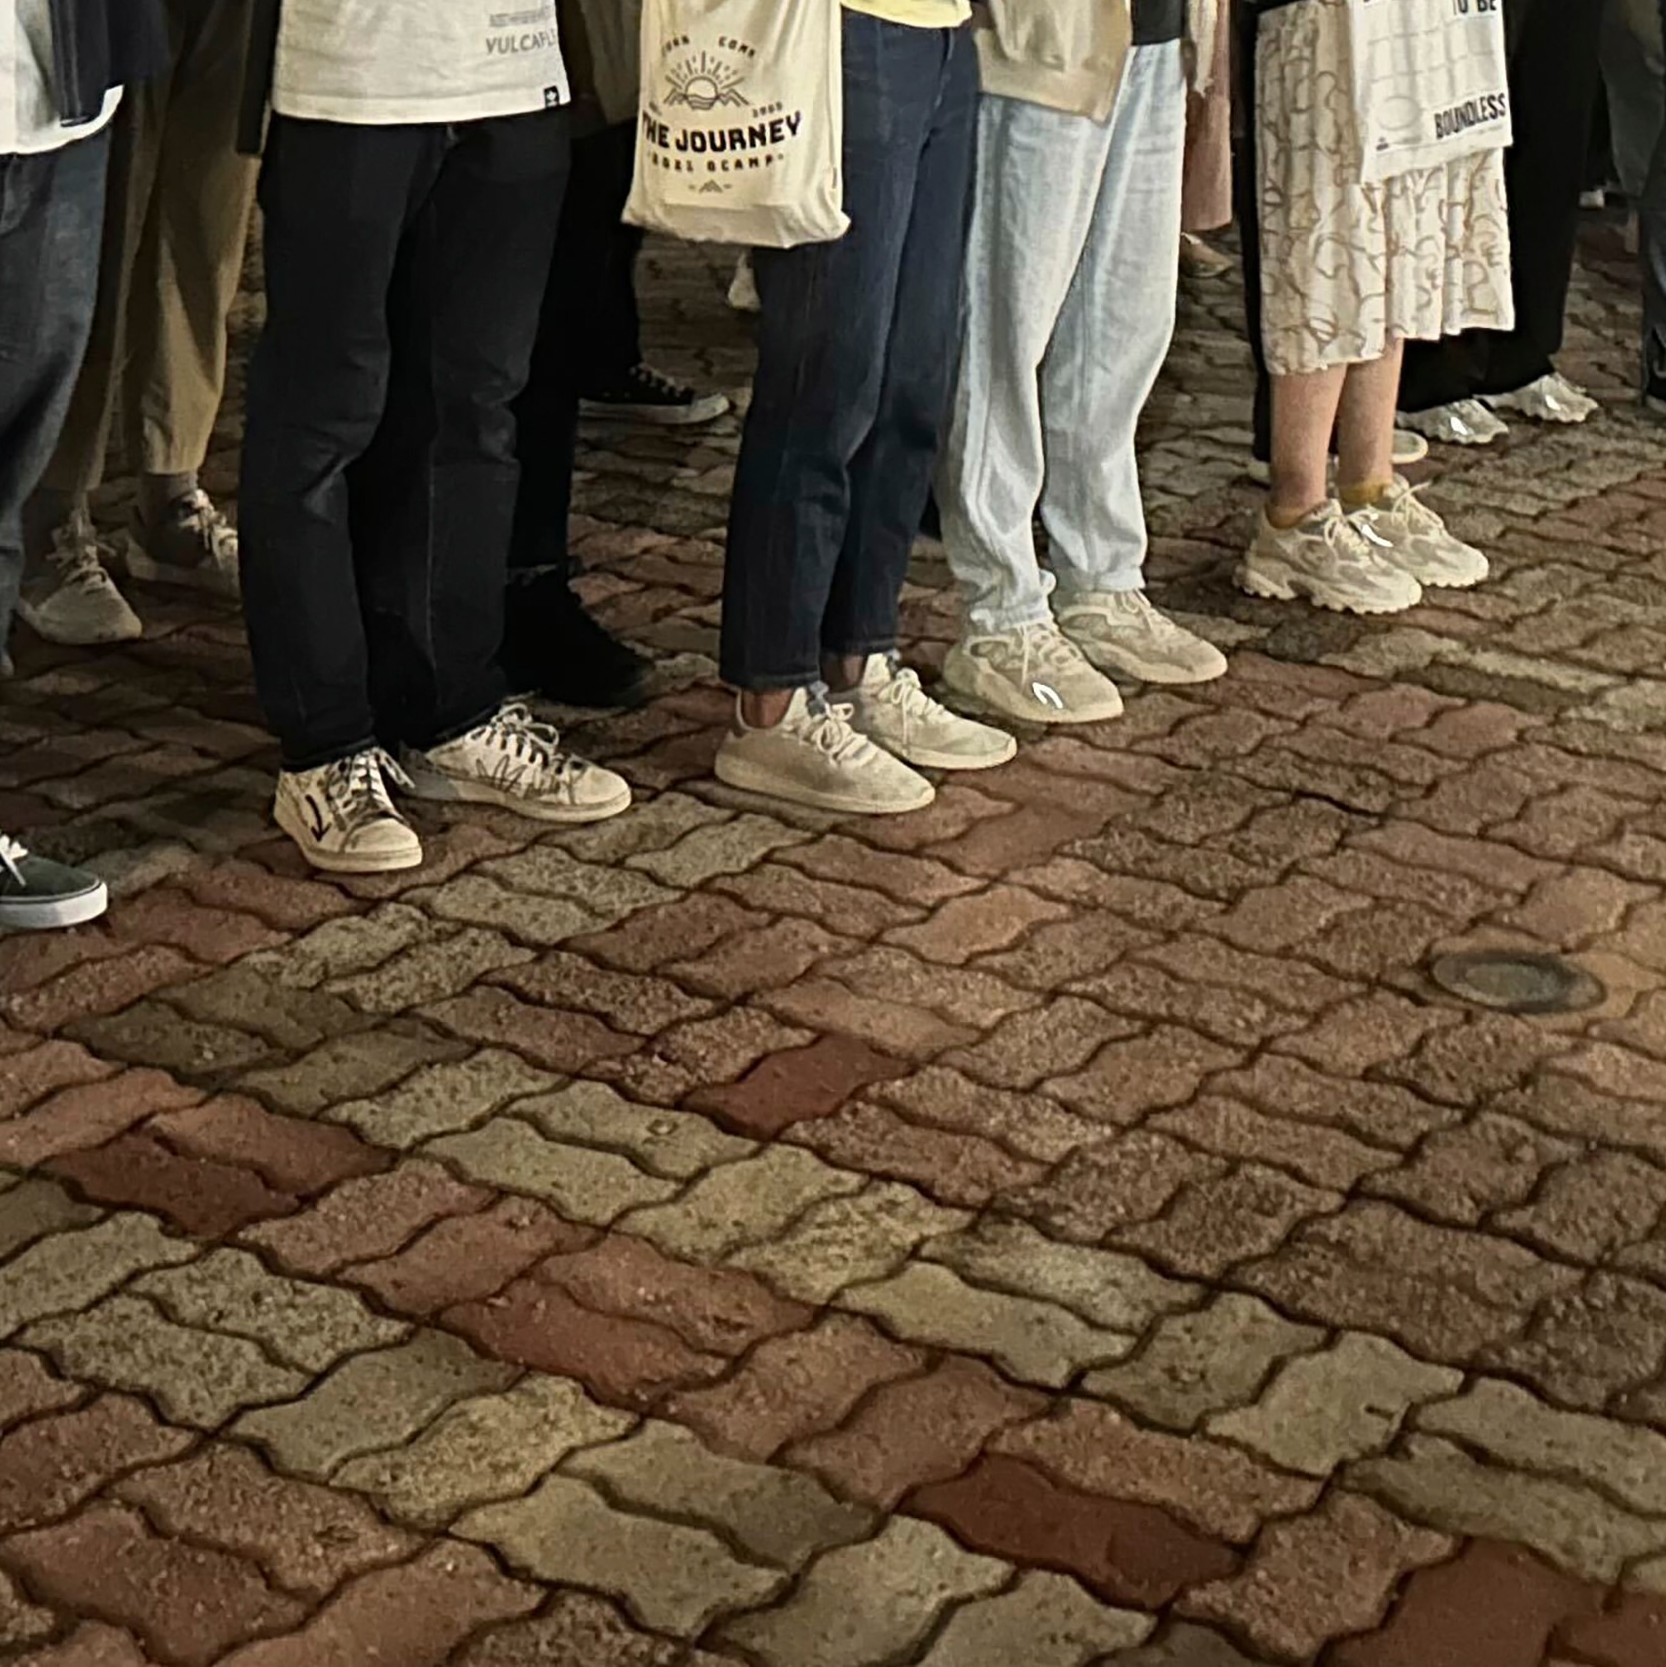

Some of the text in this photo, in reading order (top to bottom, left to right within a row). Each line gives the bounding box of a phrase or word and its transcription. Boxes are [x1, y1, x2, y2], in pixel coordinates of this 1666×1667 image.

[642, 109, 802, 153] THE JOURNEY
[1434, 92, 1506, 139] BOUNDLESS
